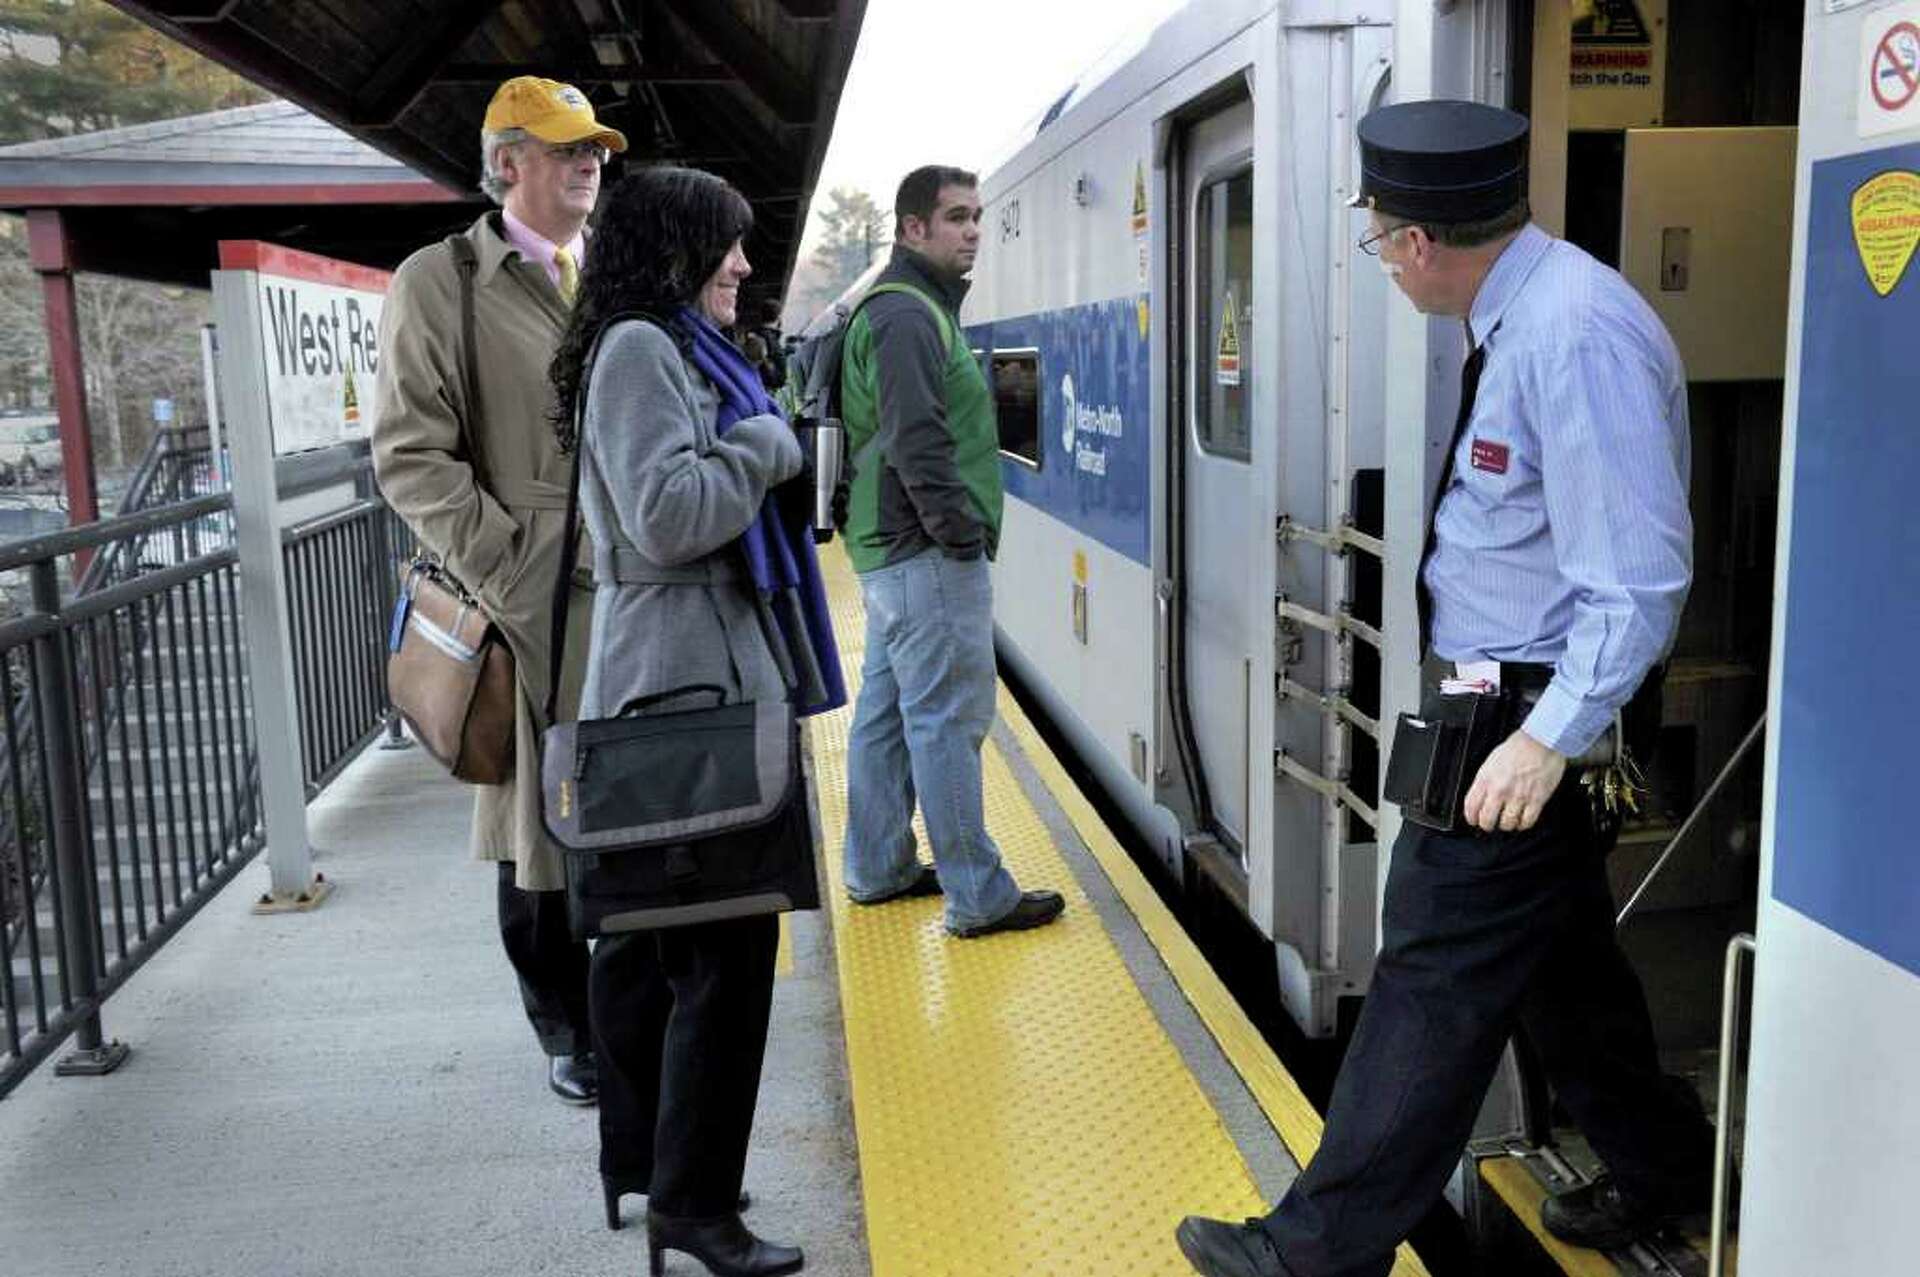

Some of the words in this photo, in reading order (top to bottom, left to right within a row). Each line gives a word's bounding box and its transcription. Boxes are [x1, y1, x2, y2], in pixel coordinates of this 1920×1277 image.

[1596, 73, 1619, 85] the
[1622, 72, 1651, 88] Gap
[266, 286, 343, 376] West
